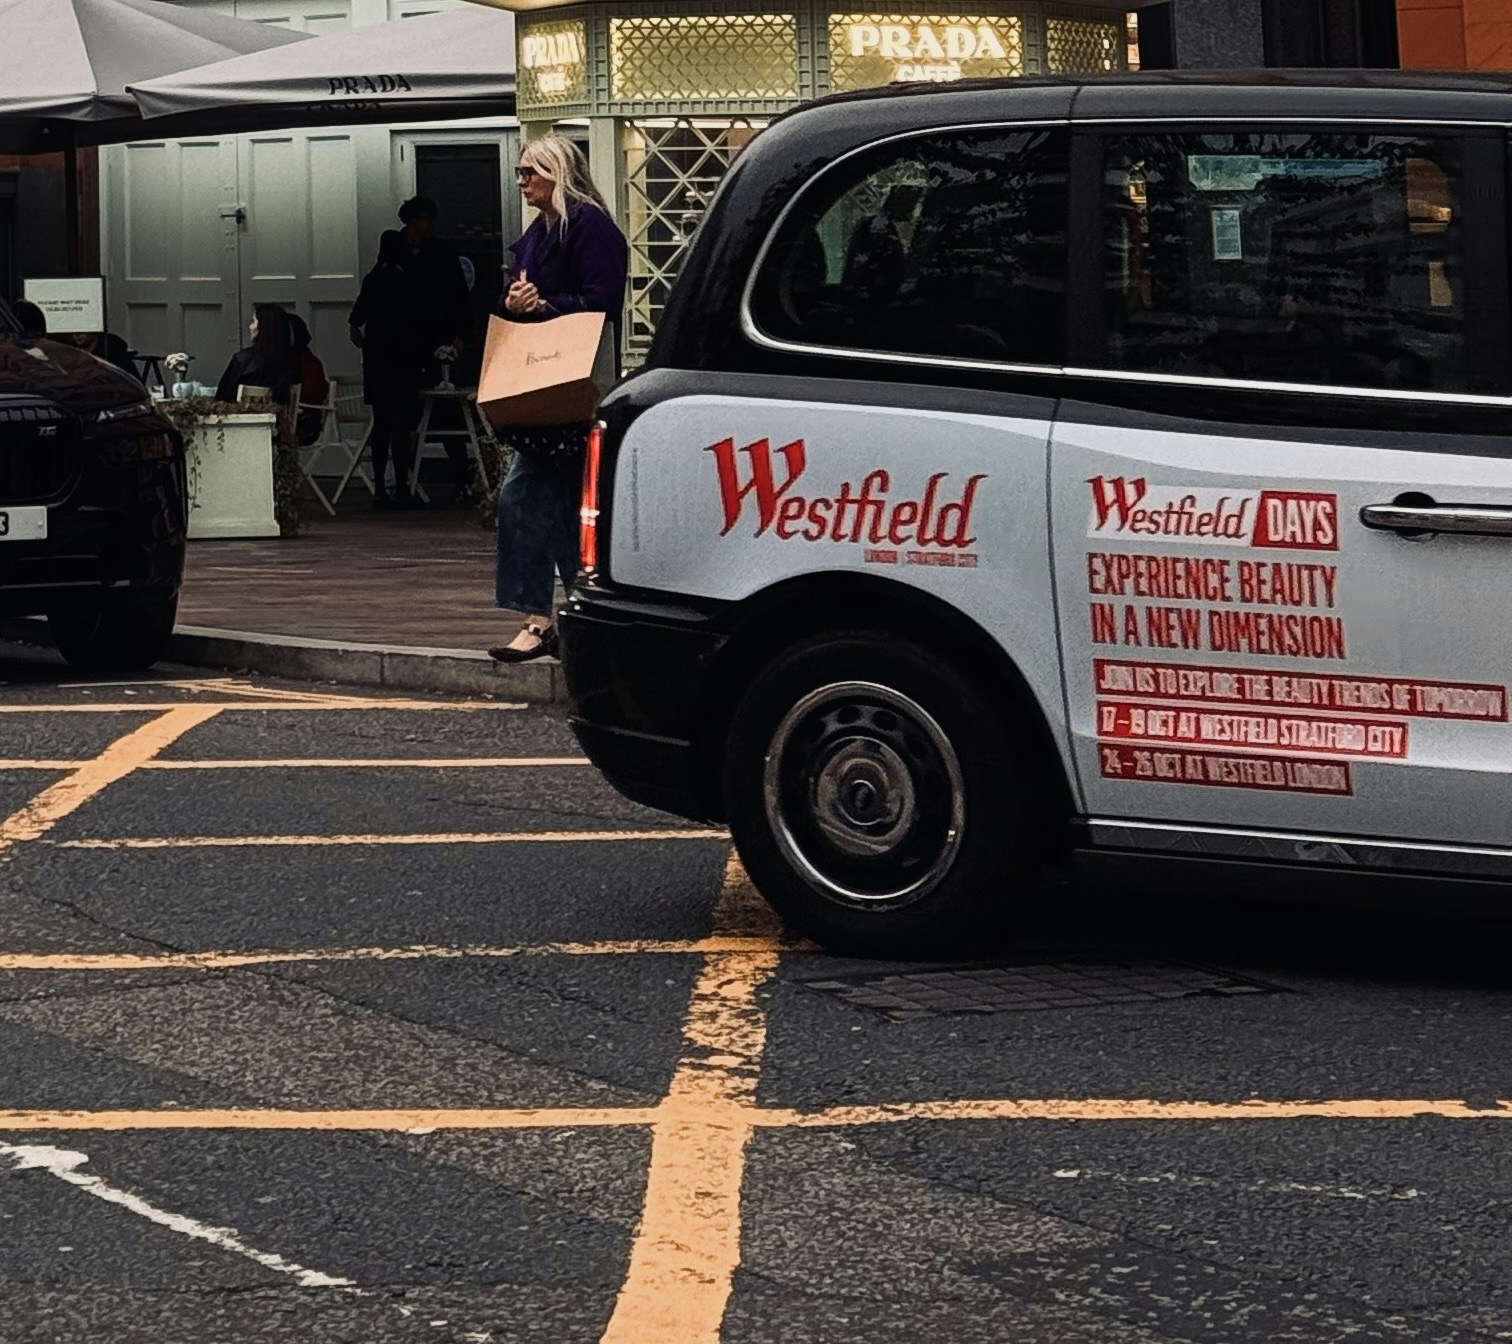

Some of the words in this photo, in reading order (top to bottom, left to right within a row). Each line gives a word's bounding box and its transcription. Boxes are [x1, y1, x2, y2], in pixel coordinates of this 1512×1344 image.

[523, 32, 580, 68] PRADA
[850, 25, 1006, 58] PRADA
[329, 74, 412, 95] PRADA
[703, 436, 988, 548] Westfield
[1084, 475, 1254, 539] Westfield
[1267, 498, 1334, 545] DAYS
[1087, 552, 1233, 602] EXPERIENCE
[1239, 560, 1337, 608] BEAUTY
[1090, 603, 1117, 645] IN
[1124, 604, 1142, 647] A
[1145, 605, 1201, 650] NEW
[1208, 609, 1347, 660] DIMENSION
[1100, 665, 1135, 691] JOIN
[1135, 667, 1155, 693] US
[1156, 668, 1177, 694] TO
[1178, 670, 1242, 699] EXPLORE
[1243, 674, 1271, 700] THE
[1272, 676, 1330, 705] BEAUTY
[1331, 679, 1391, 709] TRENDS
[1392, 683, 1411, 710] OF
[1412, 685, 1502, 717] TOMORROW
[1147, 709, 1176, 737] OCT
[1177, 711, 1197, 739] AT
[1199, 713, 1278, 744] WESTFIELD
[1280, 718, 1365, 751] STRATFORD
[1367, 726, 1403, 754] CITY
[1153, 752, 1182, 780] OCT
[1185, 755, 1204, 780] AT
[1205, 756, 1286, 786] WESTFIELD
[1288, 762, 1347, 791] LONDON
